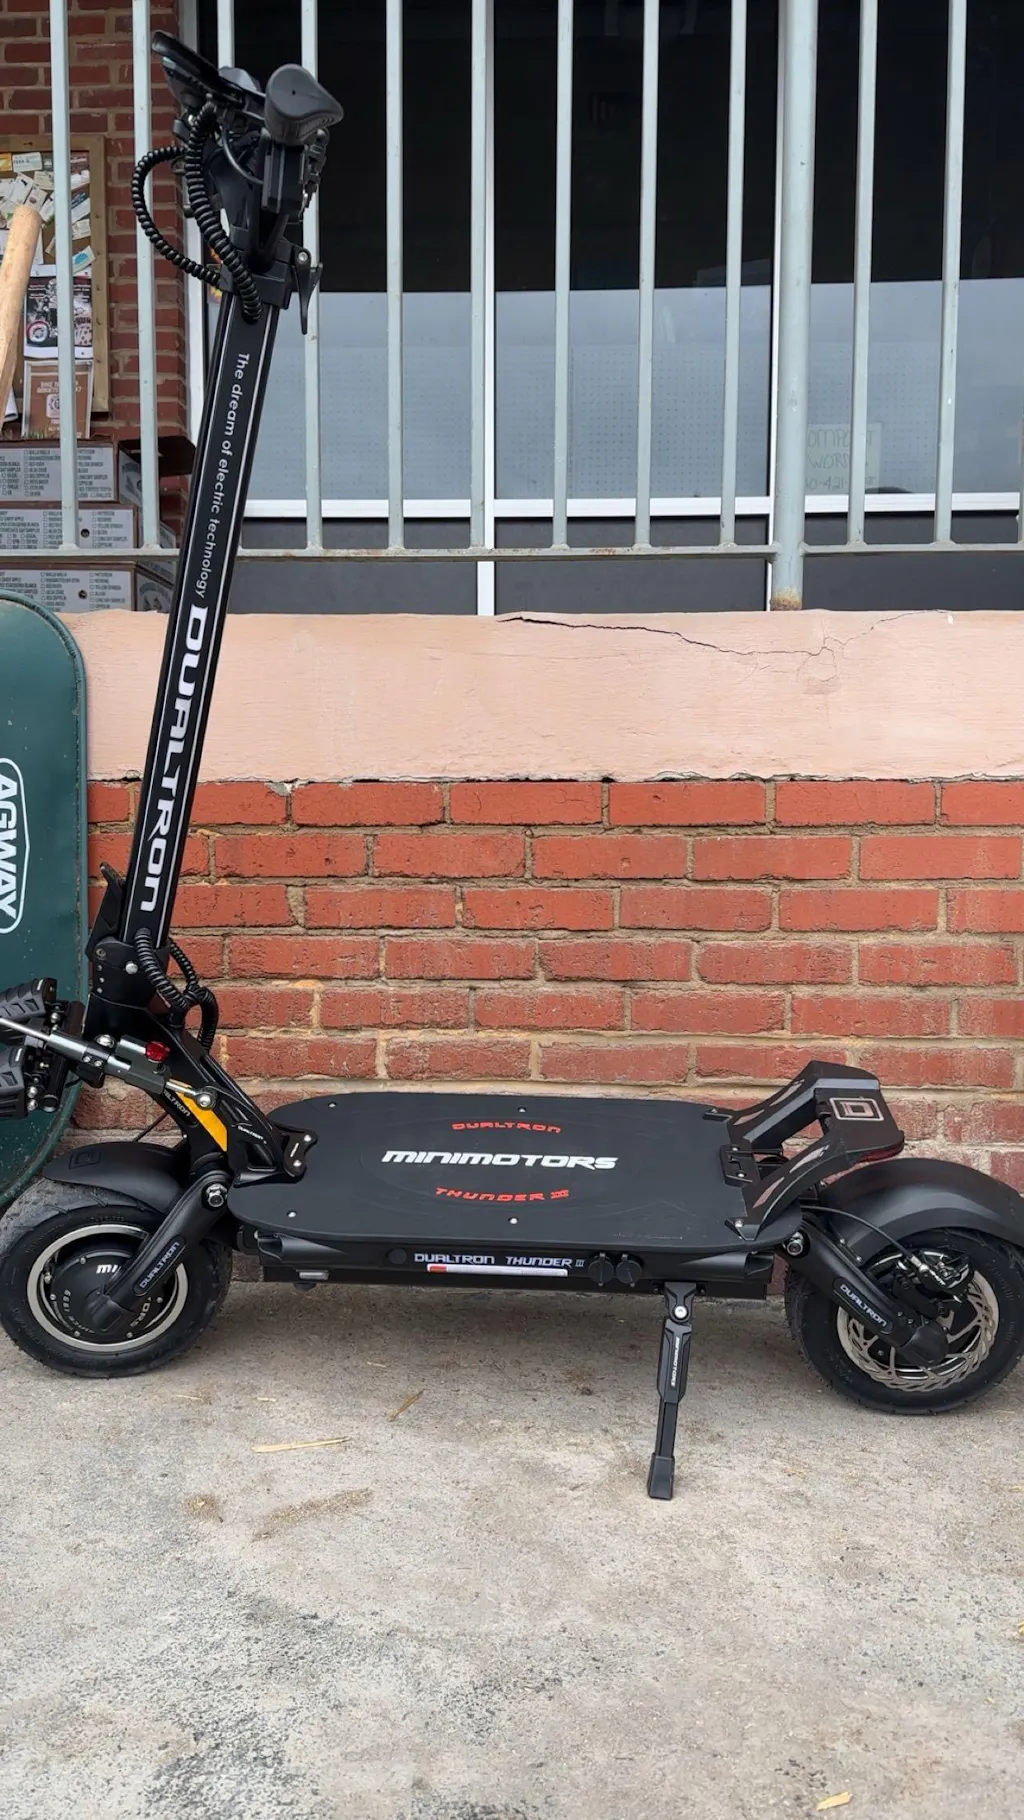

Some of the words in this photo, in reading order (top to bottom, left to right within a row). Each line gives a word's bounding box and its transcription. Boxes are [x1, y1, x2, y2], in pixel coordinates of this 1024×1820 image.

[235, 353, 250, 379] The
[224, 384, 243, 436] dream
[221, 440, 233, 456] of
[211, 459, 229, 514] electric
[195, 518, 220, 599] technology
[140, 604, 208, 912] DUALTRON
[0, 773, 18, 919] AGWAY
[452, 1121, 561, 1133] DUALTRON
[382, 1150, 619, 1170] MINIMOTORS
[435, 1187, 545, 1202] THUNDER
[139, 1241, 180, 1289] DUALTRON
[414, 1252, 495, 1267] DUALTRON
[505, 1255, 573, 1270] THUNDER
[840, 1283, 887, 1327] DUALTRON
